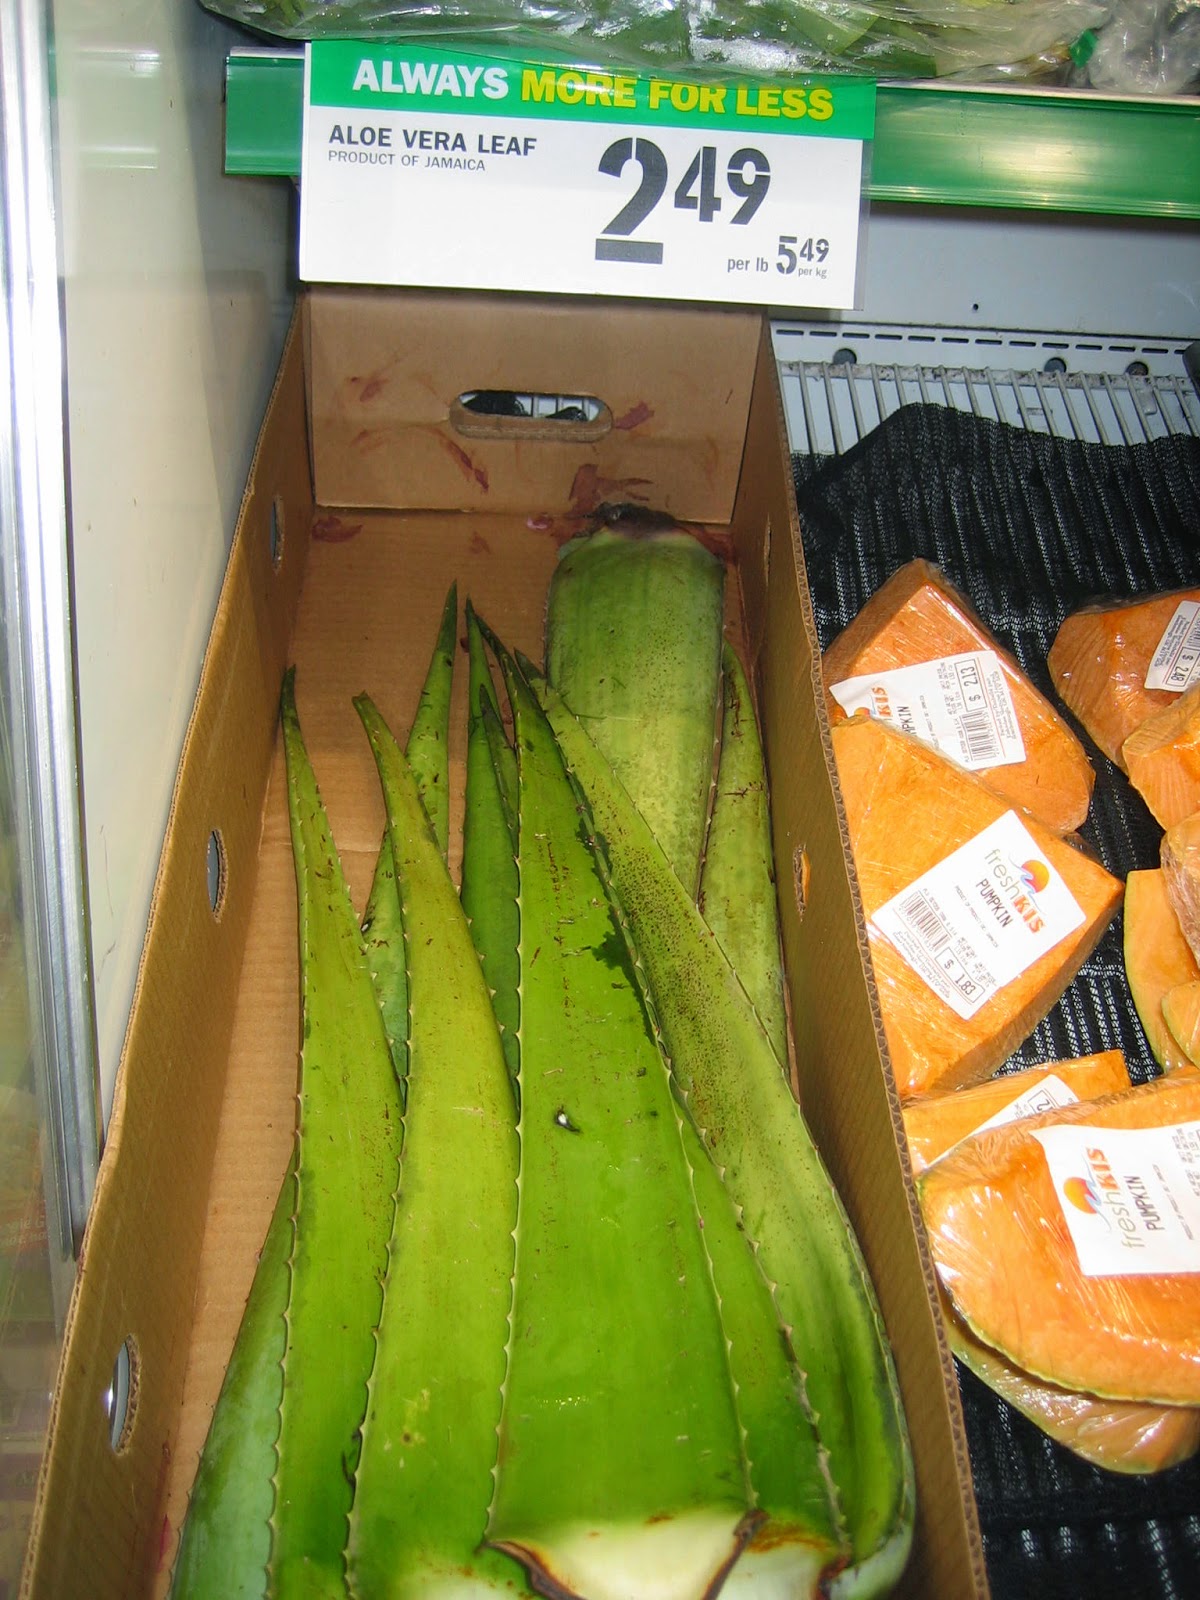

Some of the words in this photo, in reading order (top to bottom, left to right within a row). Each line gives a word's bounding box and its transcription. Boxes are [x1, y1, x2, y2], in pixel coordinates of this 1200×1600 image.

[352, 59, 509, 100] ALWAYS
[521, 69, 637, 108] MORE
[648, 78, 726, 115] FOR
[736, 85, 834, 121] LESS
[328, 124, 392, 147] ALOE
[402, 129, 467, 152] VERA
[477, 134, 537, 156] LEAF
[328, 150, 395, 166] PRODUCT
[401, 154, 420, 167] OF
[424, 156, 486, 172] JAMAICA
[727, 258, 750, 273] per
[756, 256, 769, 273] lb
[798, 267, 813, 277] per
[815, 267, 828, 279] kg
[975, 877, 1014, 929] PUMPKIN
[1123, 1175, 1165, 1232] PUMPKIN
